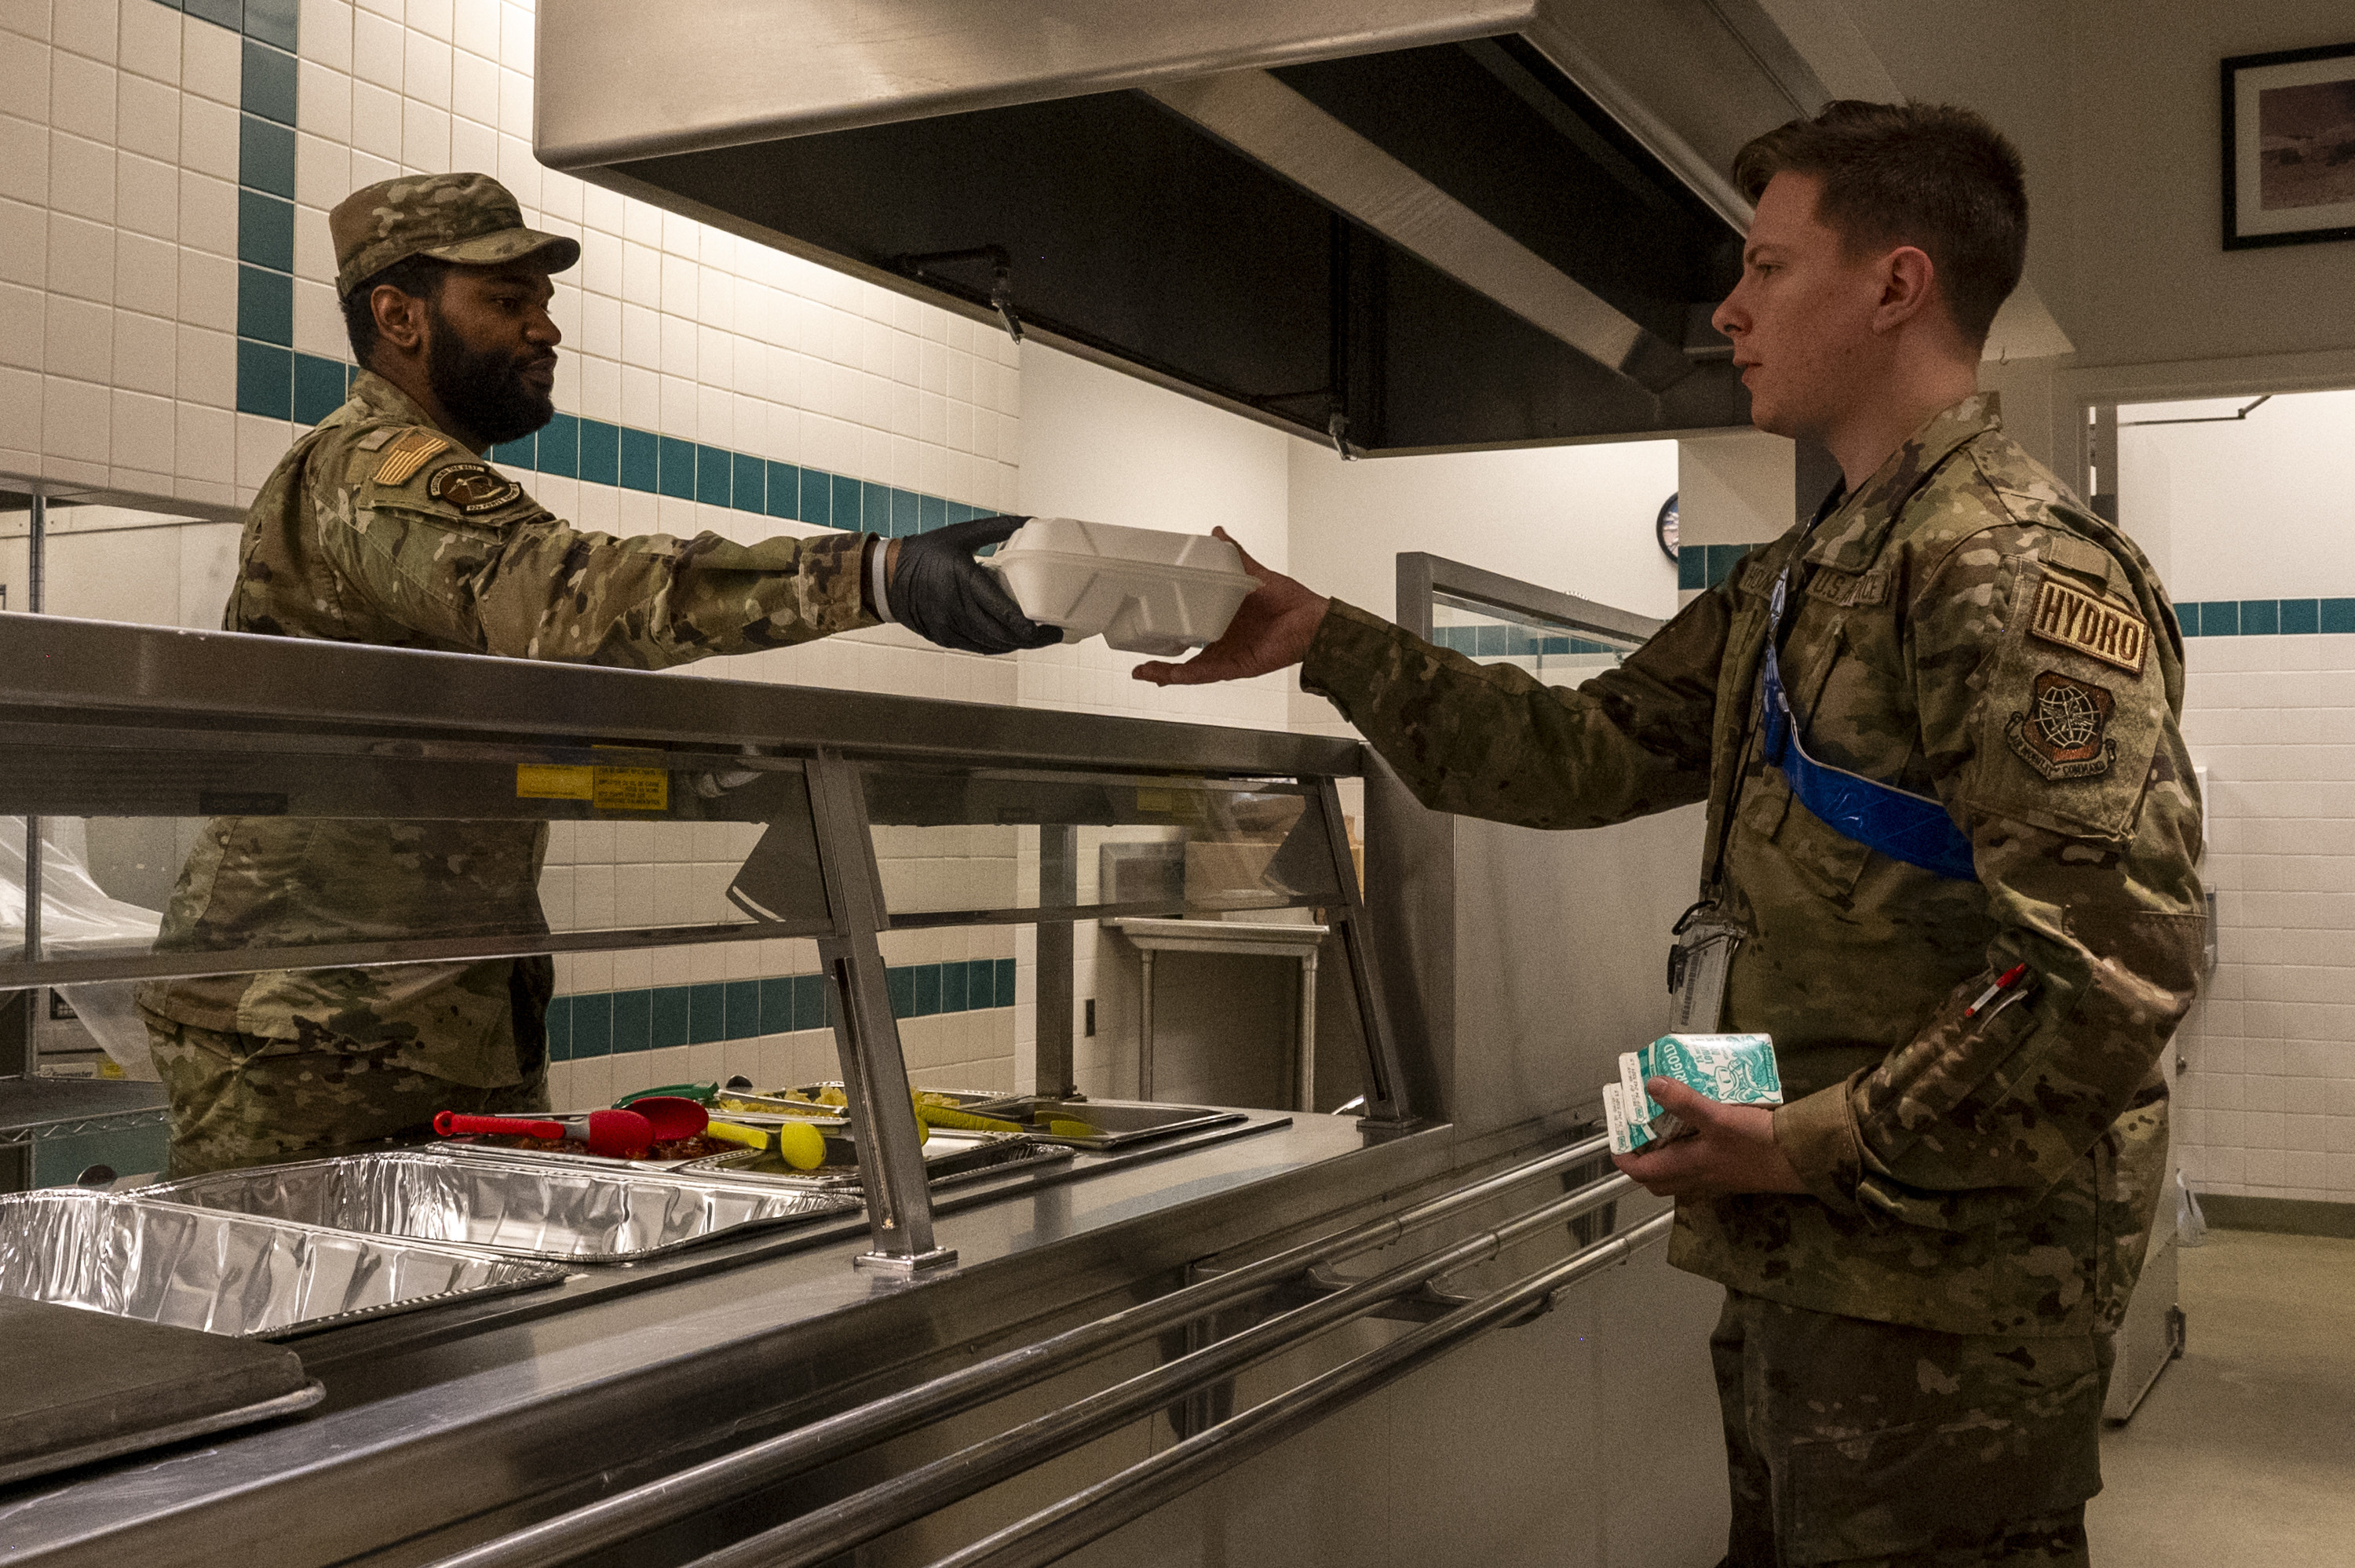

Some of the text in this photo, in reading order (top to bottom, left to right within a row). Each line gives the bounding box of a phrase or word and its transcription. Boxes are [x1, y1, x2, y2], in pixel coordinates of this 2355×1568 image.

[2040, 585, 2139, 660] HYDRO
[2062, 760, 2105, 777] COMMAND
[1663, 1043, 1690, 1085] RIGOLD
